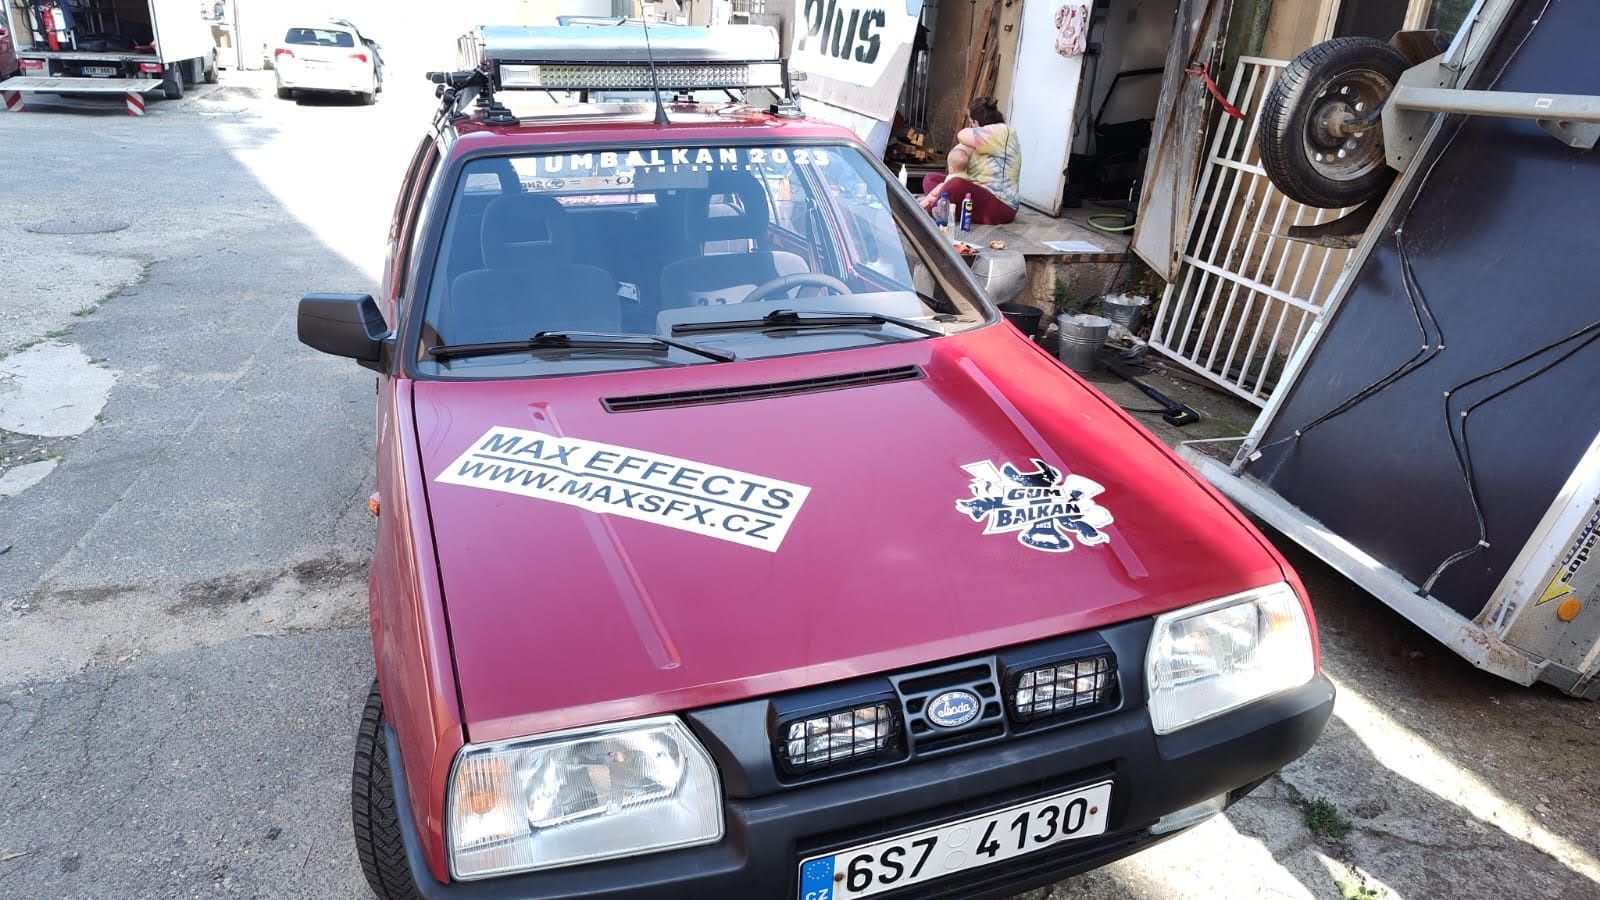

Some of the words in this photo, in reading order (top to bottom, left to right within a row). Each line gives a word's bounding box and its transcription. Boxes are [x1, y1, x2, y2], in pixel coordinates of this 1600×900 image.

[798, 0, 886, 64] Plus
[516, 148, 738, 174] UMBALKAN
[750, 148, 830, 167] 2023
[457, 460, 777, 540] WWW.MAXSFX.CZ
[480, 433, 580, 466] MAX
[584, 450, 795, 511] EFFECTS
[1007, 487, 1062, 500] GUM
[996, 503, 1081, 528] BALKAN
[846, 836, 939, 893] 6S7
[976, 797, 1088, 858] 4130
